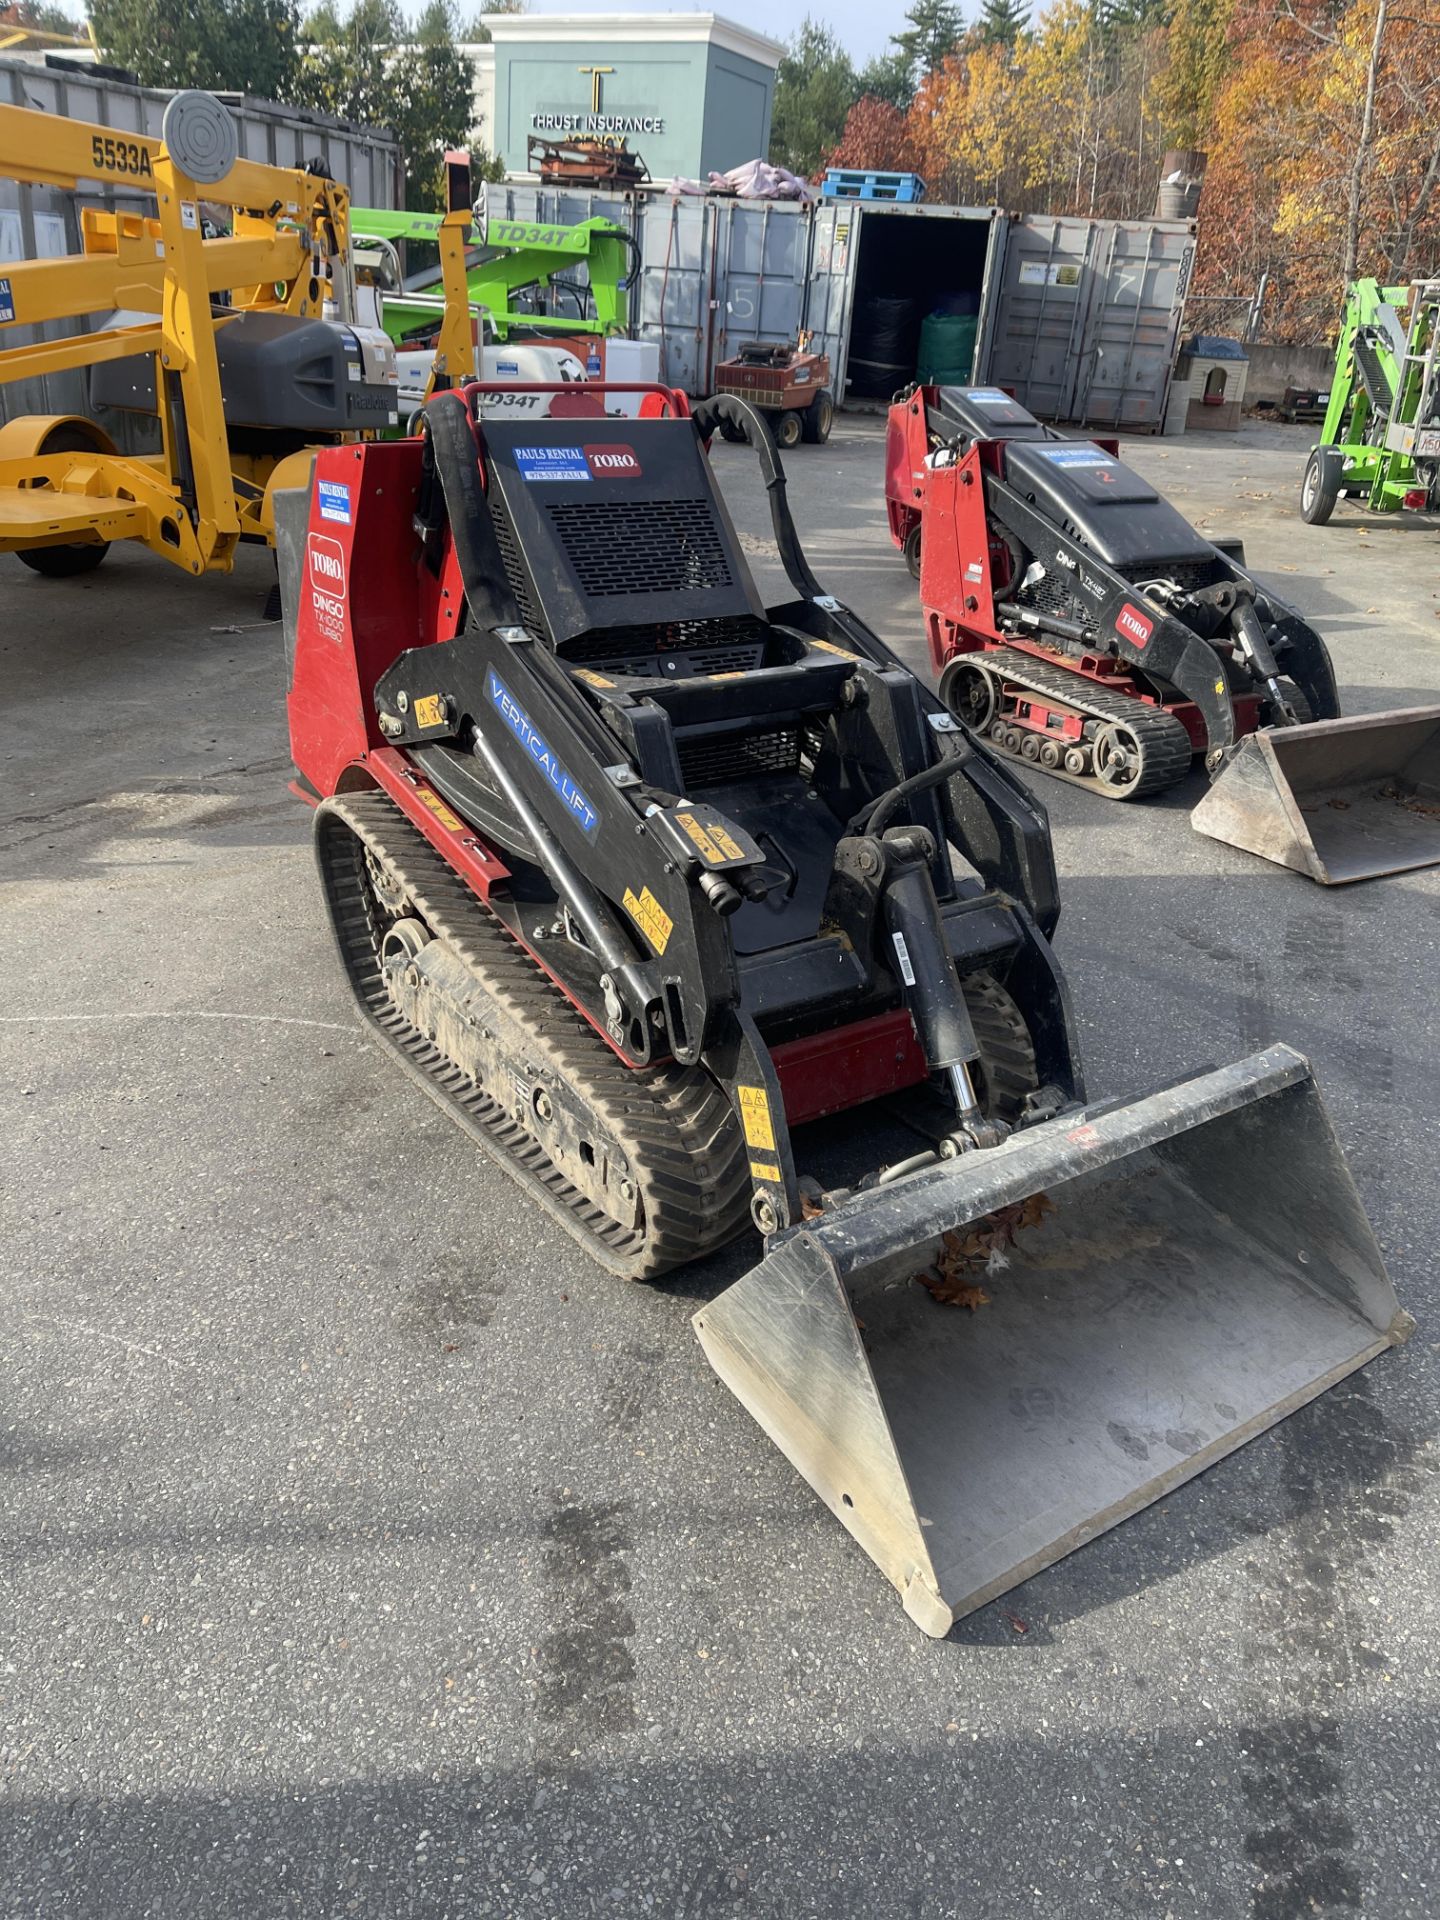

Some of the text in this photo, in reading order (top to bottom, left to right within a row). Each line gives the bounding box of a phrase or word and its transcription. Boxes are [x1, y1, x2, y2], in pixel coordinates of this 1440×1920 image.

[530, 114, 662, 132] THRUST INSURANCE
[92, 136, 151, 177] 5533A
[497, 225, 569, 246] TD34T
[1114, 272, 1136, 303] 7
[732, 289, 754, 318] 5
[514, 448, 583, 460] PAULS RENTAL
[590, 454, 635, 468] TORO
[1095, 470, 1117, 483] 2
[311, 550, 342, 580] TORO
[313, 592, 343, 618] DINGO
[318, 623, 343, 643] TURBO
[1122, 611, 1148, 639] TORO
[492, 680, 594, 825] VERTICAL LIFT
